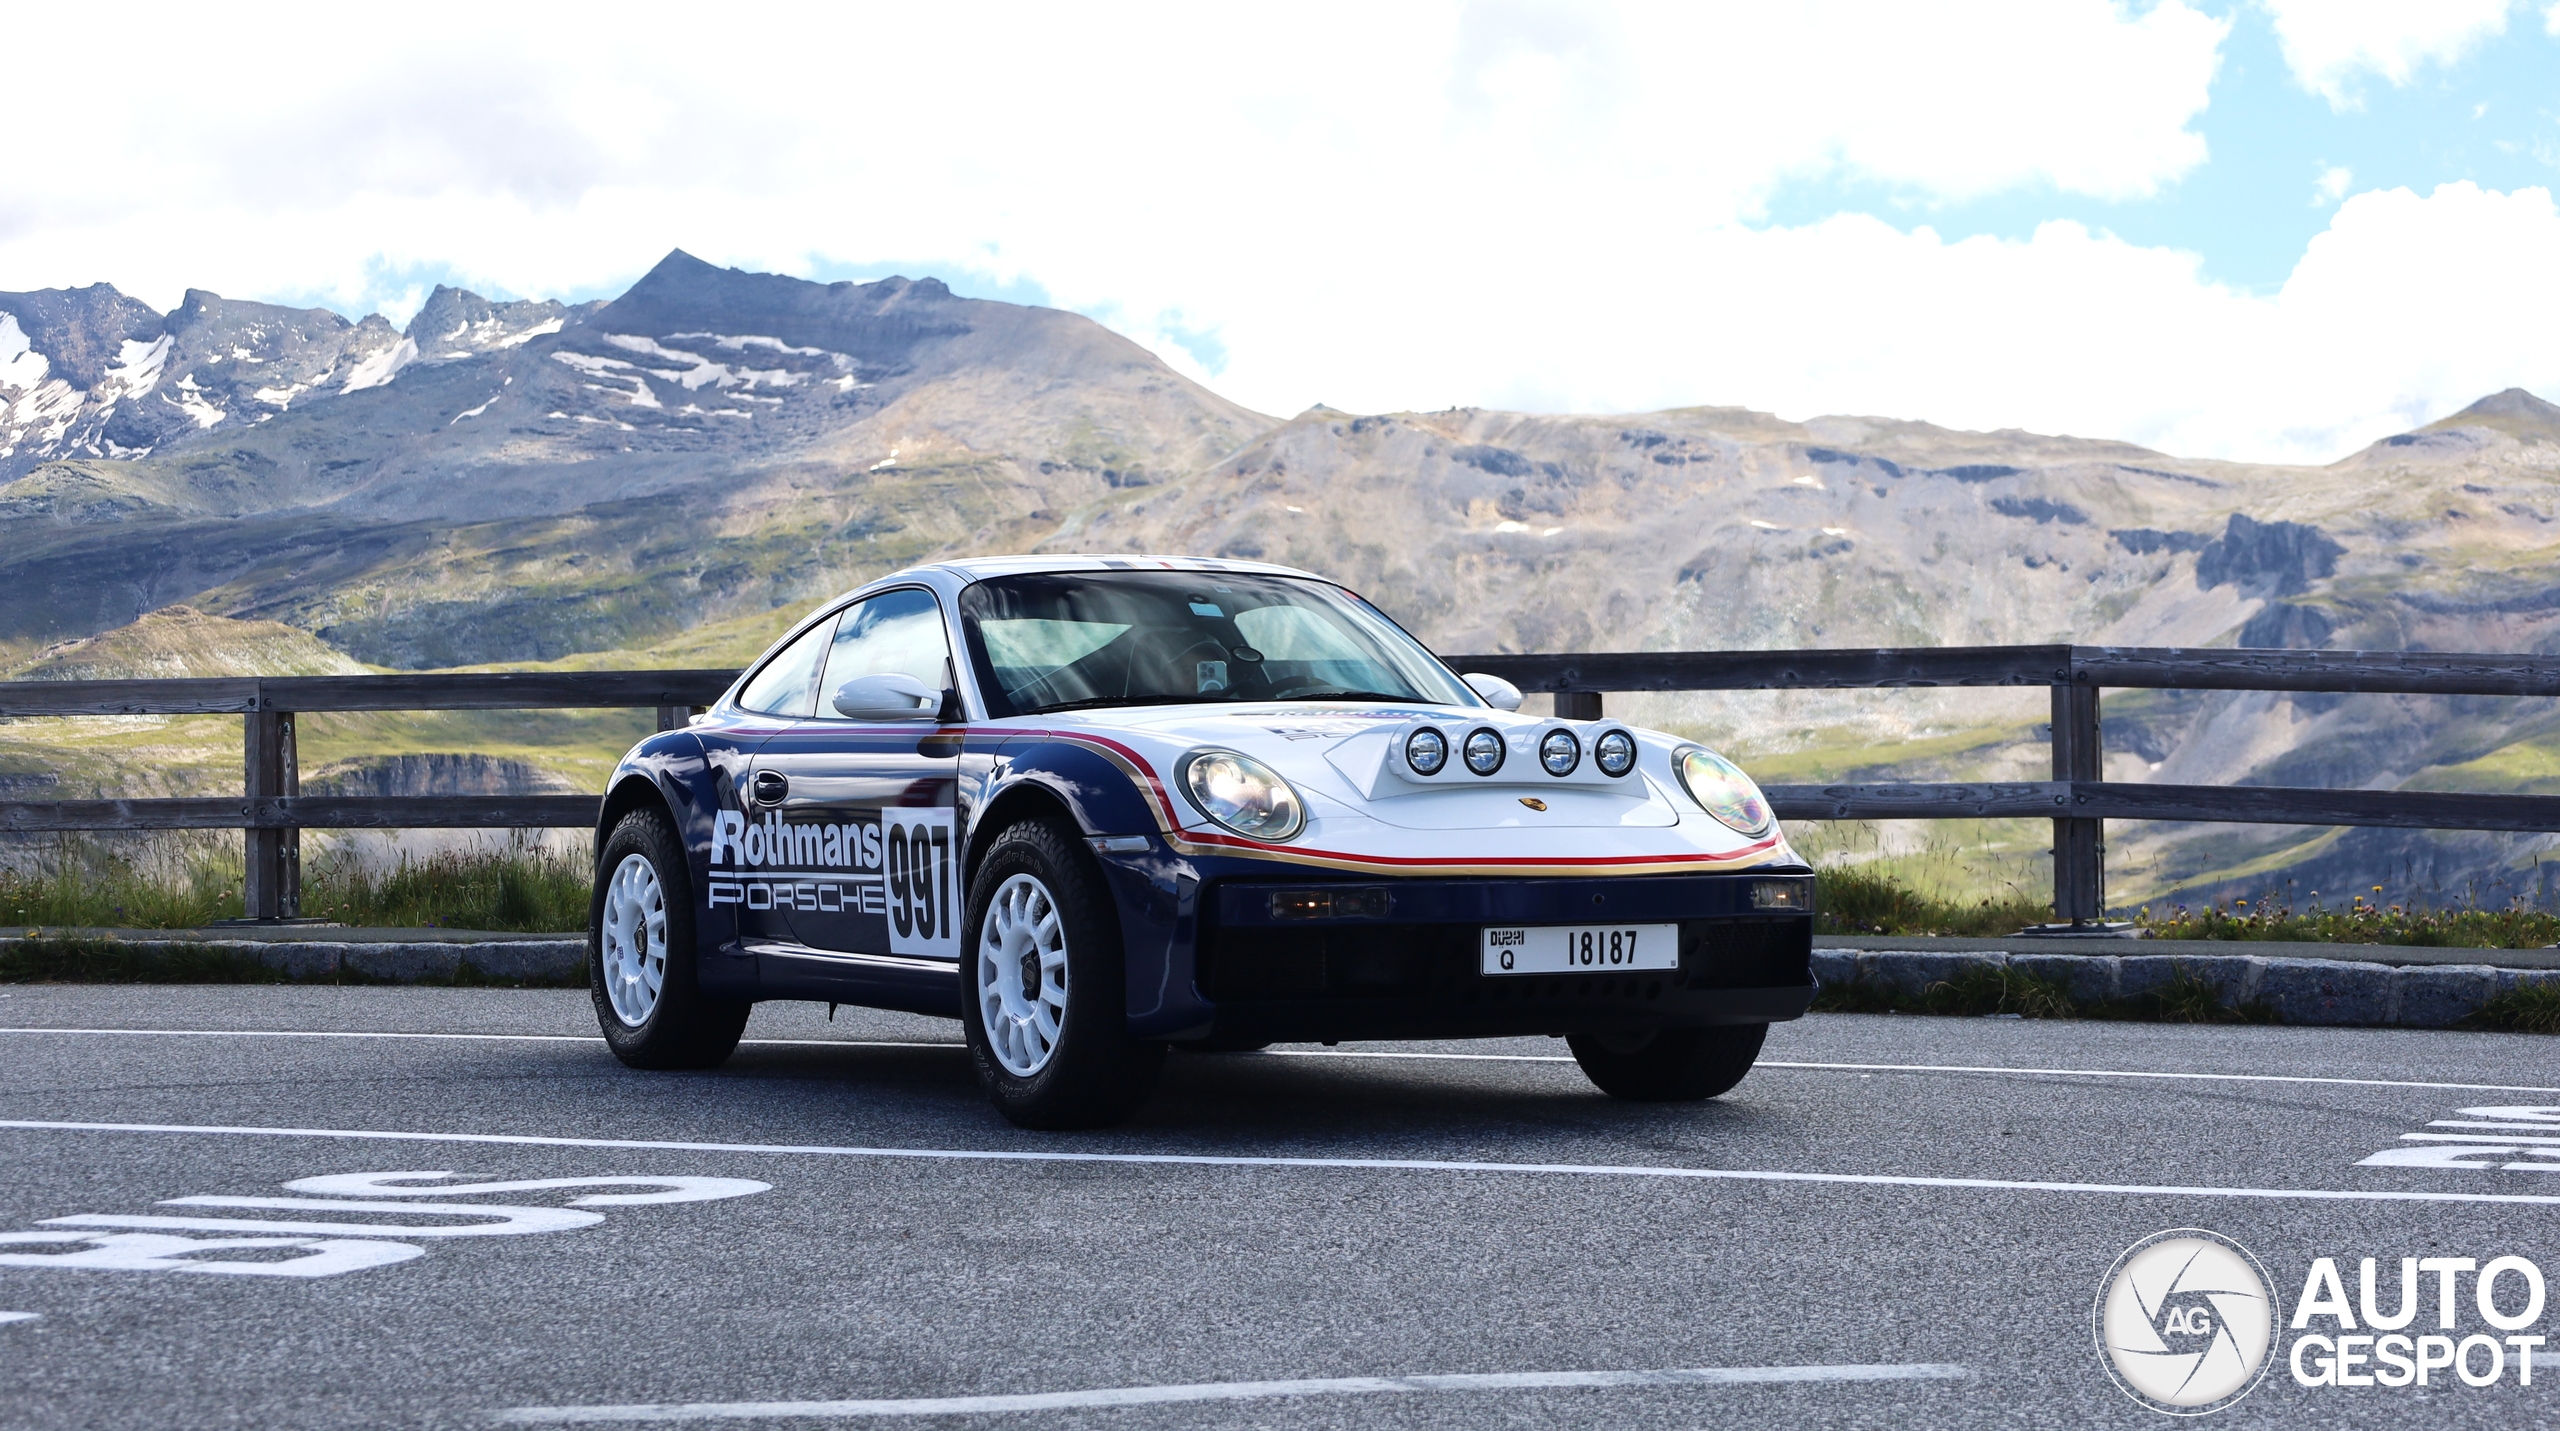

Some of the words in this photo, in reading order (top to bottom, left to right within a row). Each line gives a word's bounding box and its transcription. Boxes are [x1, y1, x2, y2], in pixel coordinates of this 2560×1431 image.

[711, 808, 882, 869] Rothmans
[708, 882, 886, 914] PORSCHE
[888, 823, 951, 940] 997
[966, 850, 1044, 934] BFGoodrich
[1500, 949, 1515, 971] Q
[1569, 930, 1637, 966] 18187
[974, 1044, 995, 1083] T/A
[0, 1170, 774, 1277] BUS
